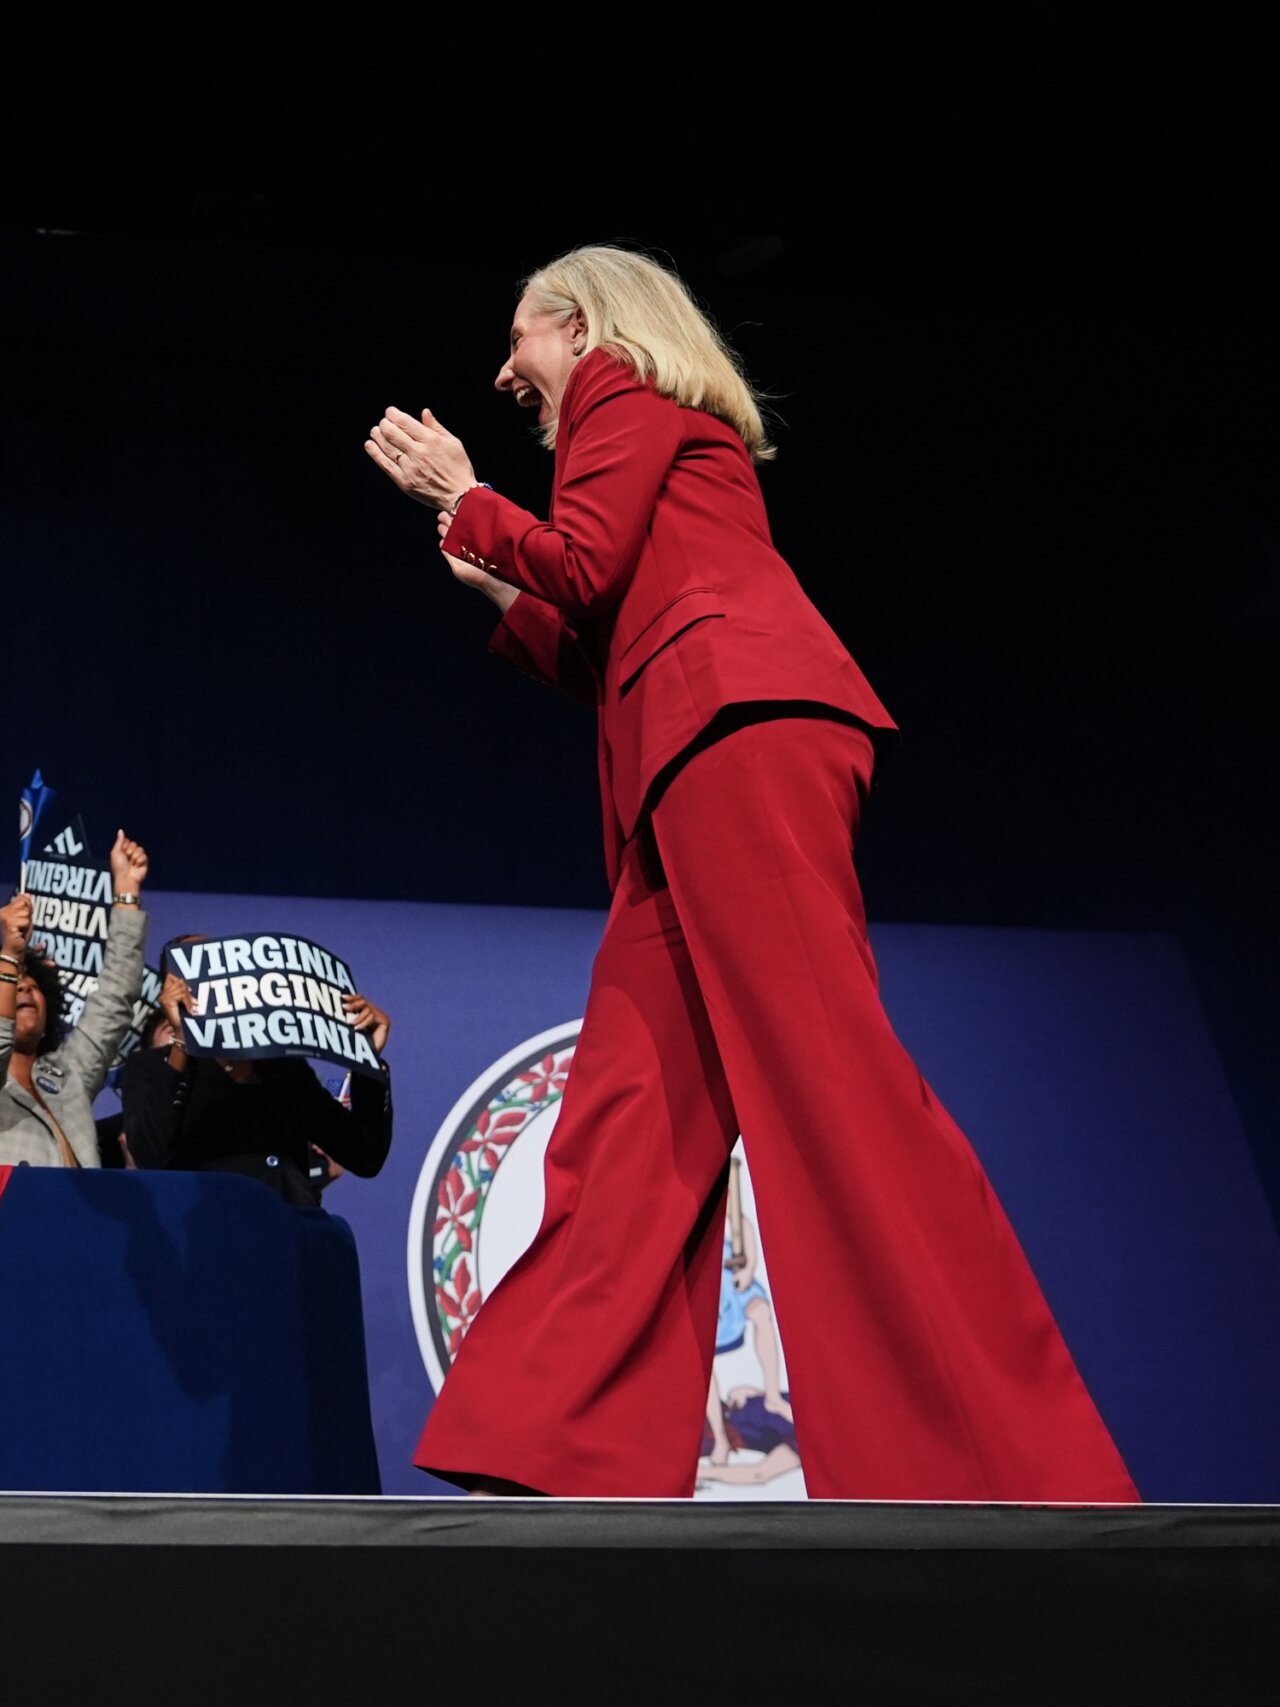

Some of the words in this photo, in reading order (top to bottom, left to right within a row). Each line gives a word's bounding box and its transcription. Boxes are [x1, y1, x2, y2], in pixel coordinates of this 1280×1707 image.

[171, 936, 357, 995] VIRGINIA
[194, 972, 360, 1024] VIRGINI
[185, 1009, 381, 1070] VIRGINIA
